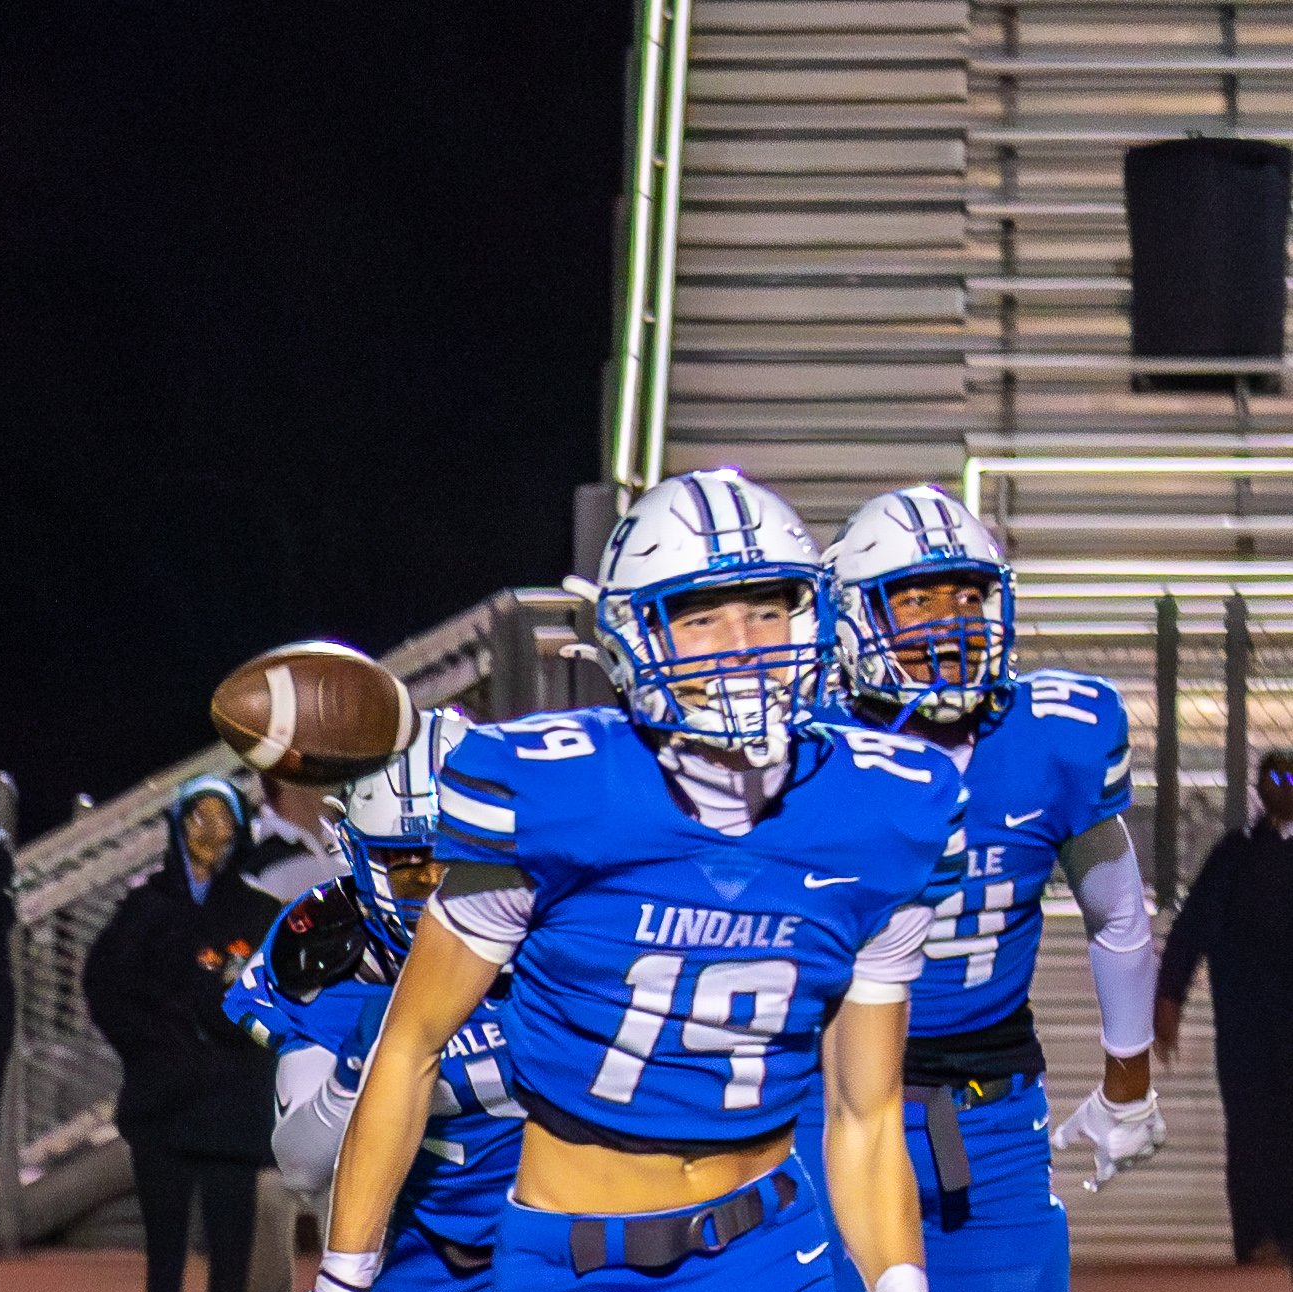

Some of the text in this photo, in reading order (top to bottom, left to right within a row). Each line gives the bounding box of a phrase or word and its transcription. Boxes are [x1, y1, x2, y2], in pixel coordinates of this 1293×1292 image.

[1031, 680, 1099, 725] 14
[844, 731, 932, 784] 19
[635, 903, 804, 948] LINDALE
[588, 950, 799, 1110] 19
